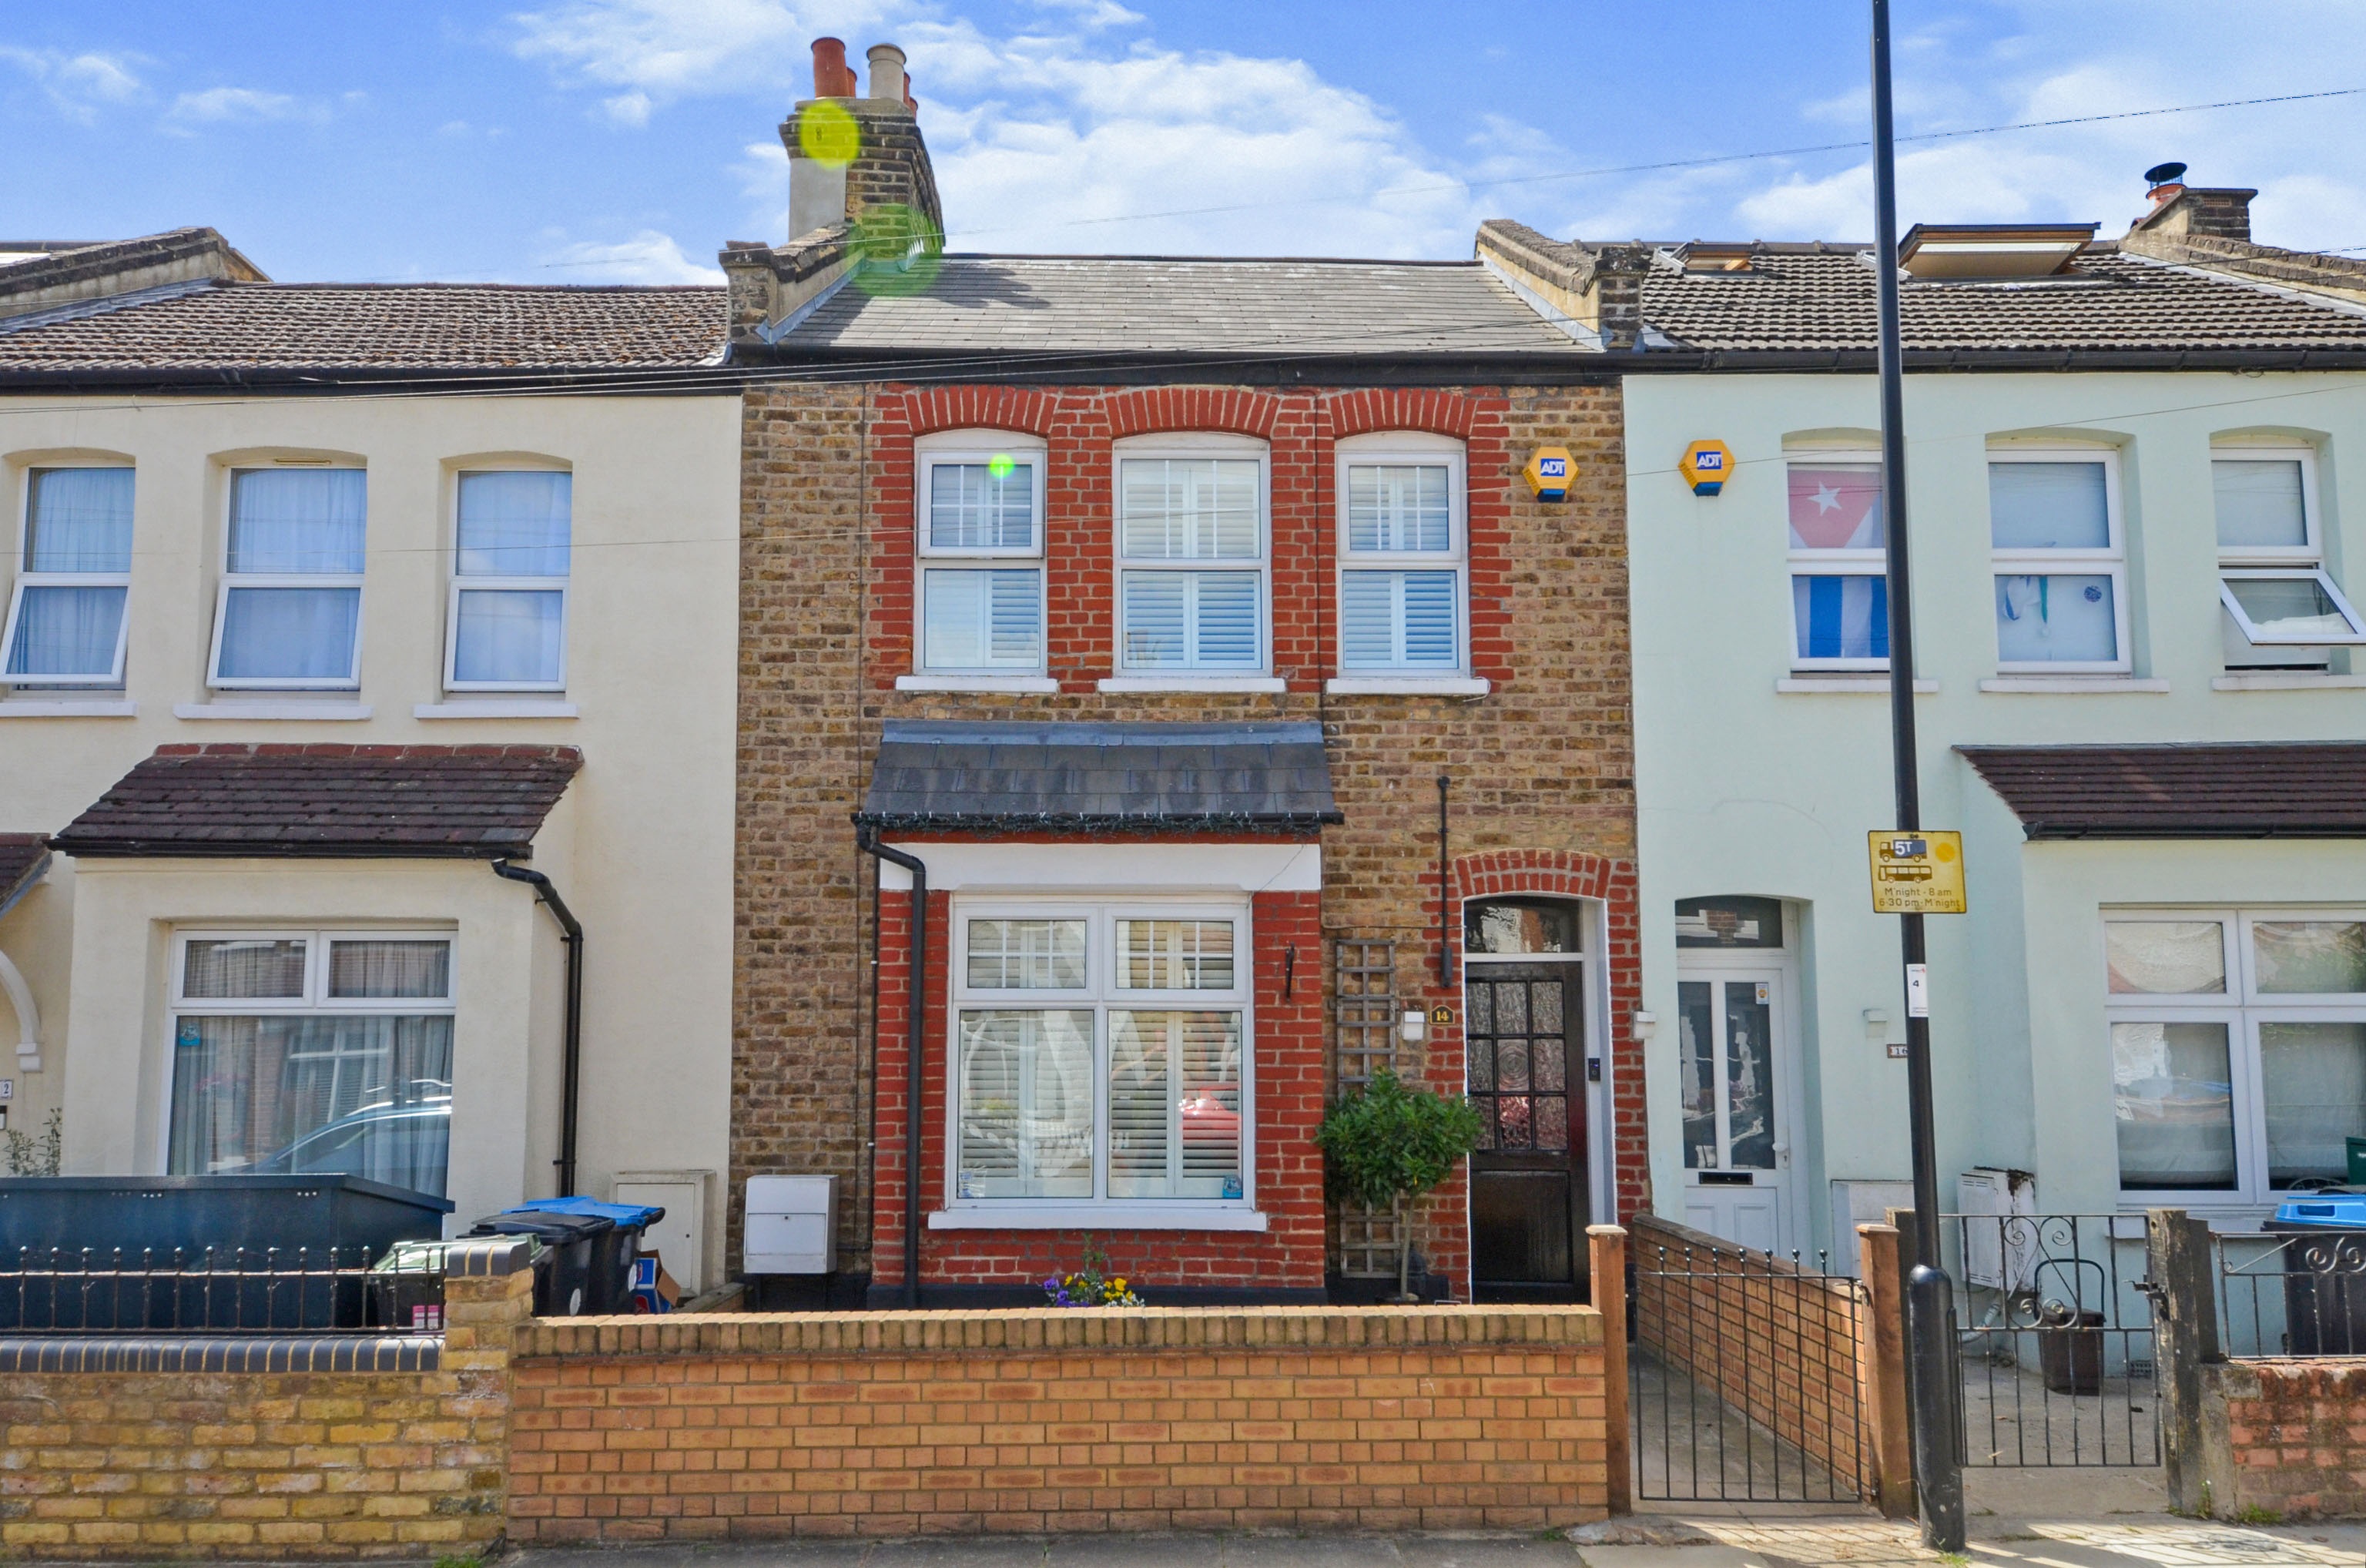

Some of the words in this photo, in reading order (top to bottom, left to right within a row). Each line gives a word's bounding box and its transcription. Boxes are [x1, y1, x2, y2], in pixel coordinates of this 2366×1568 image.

[1697, 454, 1722, 467] ADT
[1540, 461, 1565, 474] ADT
[1929, 887, 1935, 896] 8
[1436, 1011, 1449, 1021] 14
[4, 1083, 9, 1094] 2
